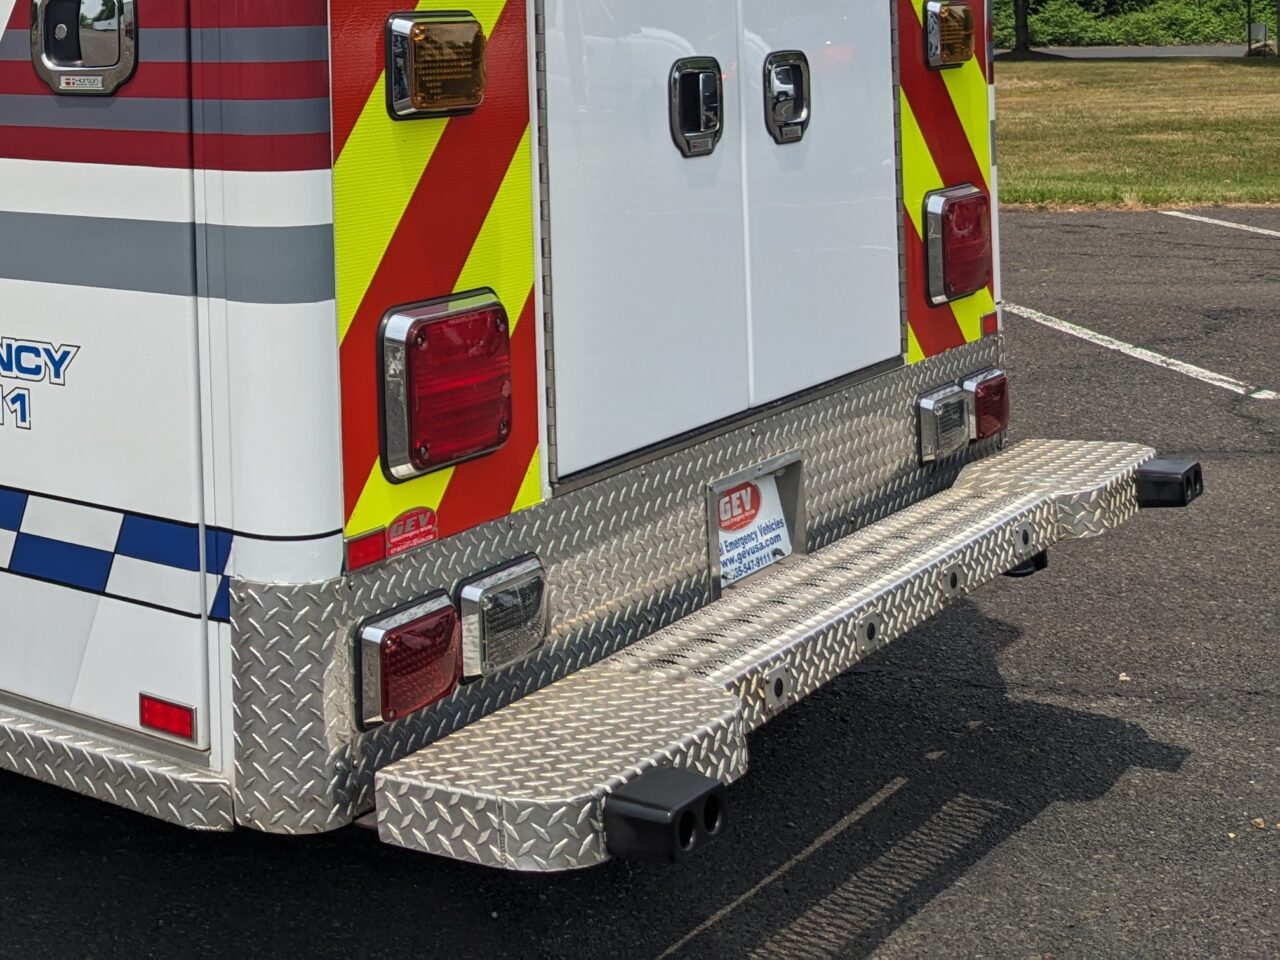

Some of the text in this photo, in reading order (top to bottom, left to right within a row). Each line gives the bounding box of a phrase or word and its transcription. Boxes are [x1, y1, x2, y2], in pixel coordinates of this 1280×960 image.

[720, 487, 752, 521] GEV
[390, 511, 431, 539] GEV
[725, 530, 759, 553] Emergency
[758, 517, 785, 538] Vehicles
[721, 532, 782, 569] ww.gevusa.com
